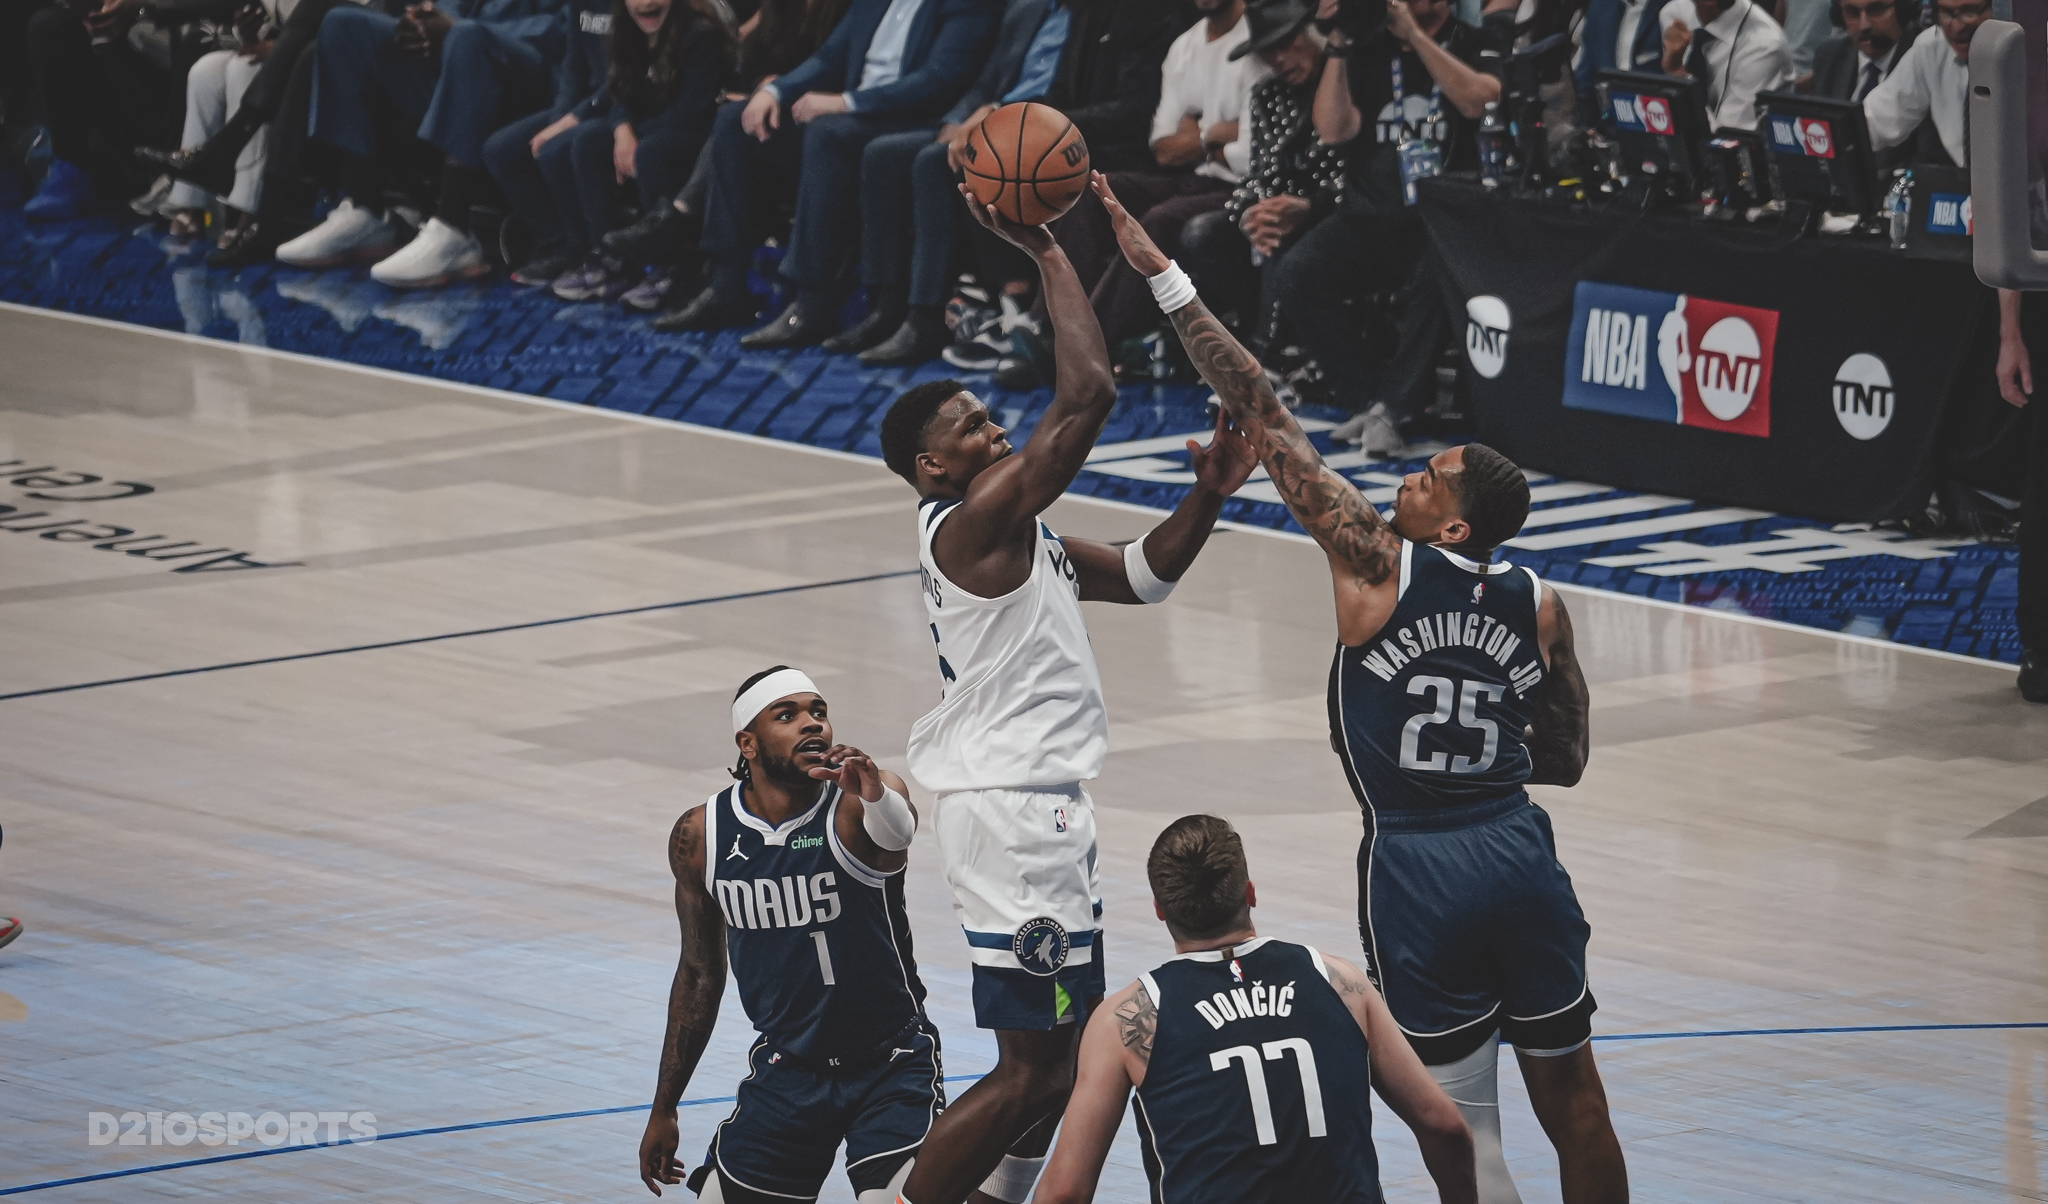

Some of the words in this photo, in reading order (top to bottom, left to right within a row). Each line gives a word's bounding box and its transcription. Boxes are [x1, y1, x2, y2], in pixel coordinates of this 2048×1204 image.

[1932, 201, 1958, 226] NBA
[1581, 307, 1648, 391] NBA
[1697, 348, 1762, 395] TNT
[1833, 379, 1896, 418] TNT
[1361, 612, 1521, 682] WASHINGTON
[1508, 659, 1542, 700] JR.
[1400, 675, 1507, 773] 25
[791, 836, 823, 850] chime
[716, 871, 842, 930] MAVS
[809, 930, 836, 986] 1
[1015, 919, 1041, 955] MINNESOTA
[1043, 919, 1068, 965] TIMBERWOLVES
[1194, 980, 1296, 1031] DONČIĆ
[1209, 1037, 1328, 1146] 77
